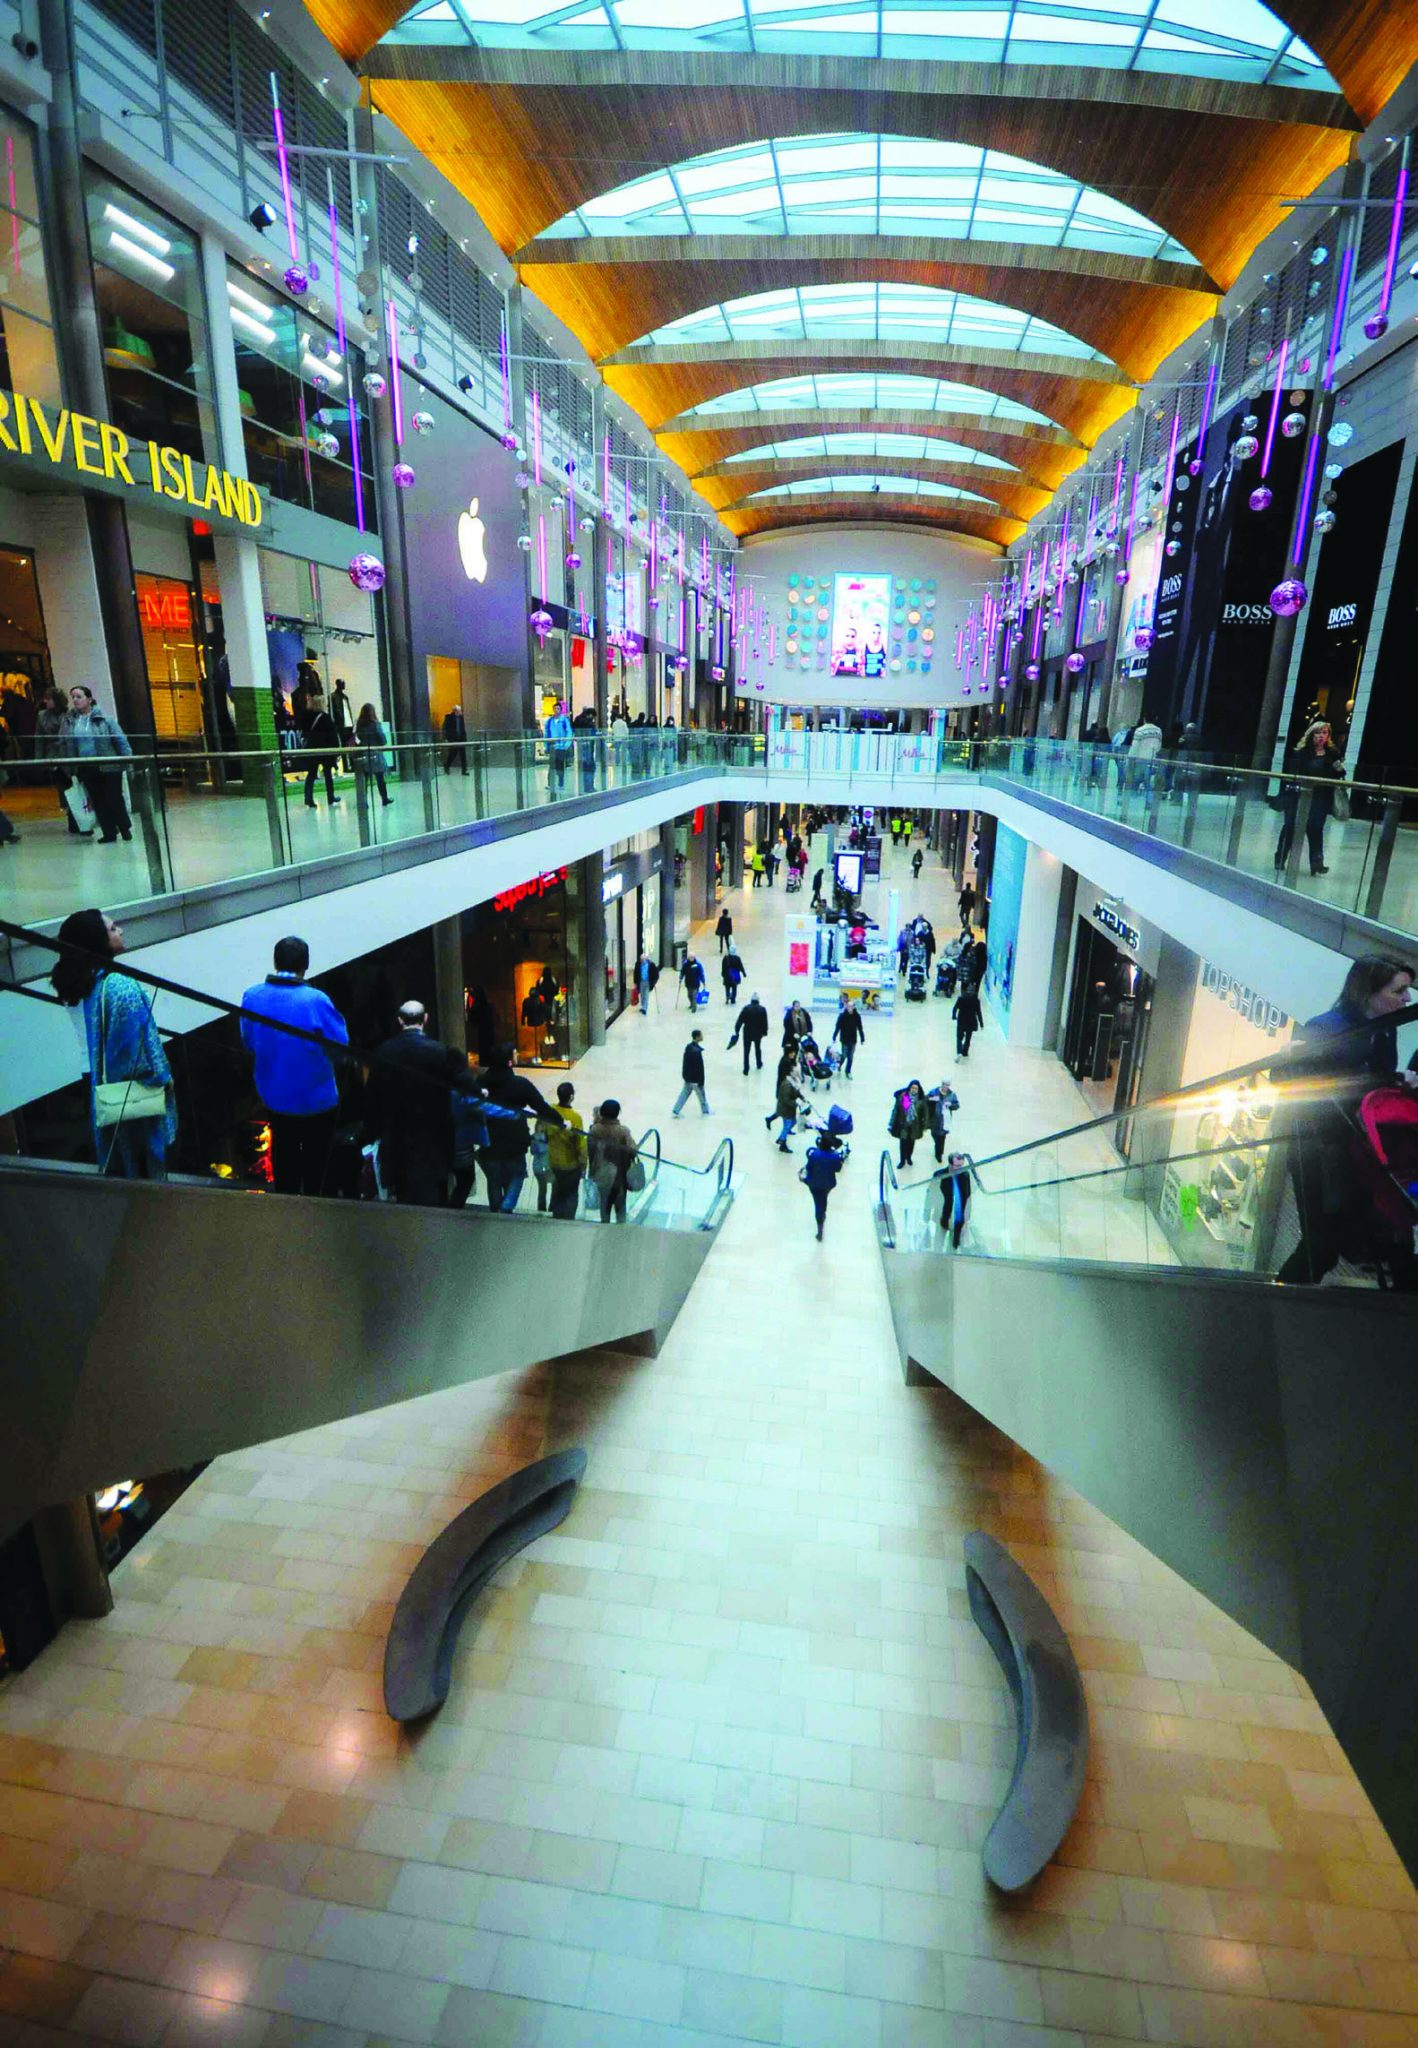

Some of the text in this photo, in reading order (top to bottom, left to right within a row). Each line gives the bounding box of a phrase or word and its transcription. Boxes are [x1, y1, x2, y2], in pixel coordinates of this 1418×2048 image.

[149, 440, 262, 527] ISLAND
[1222, 604, 1272, 620] BOSS
[1328, 603, 1357, 624] BOSS
[1200, 957, 1289, 1038] TOPSHOP
